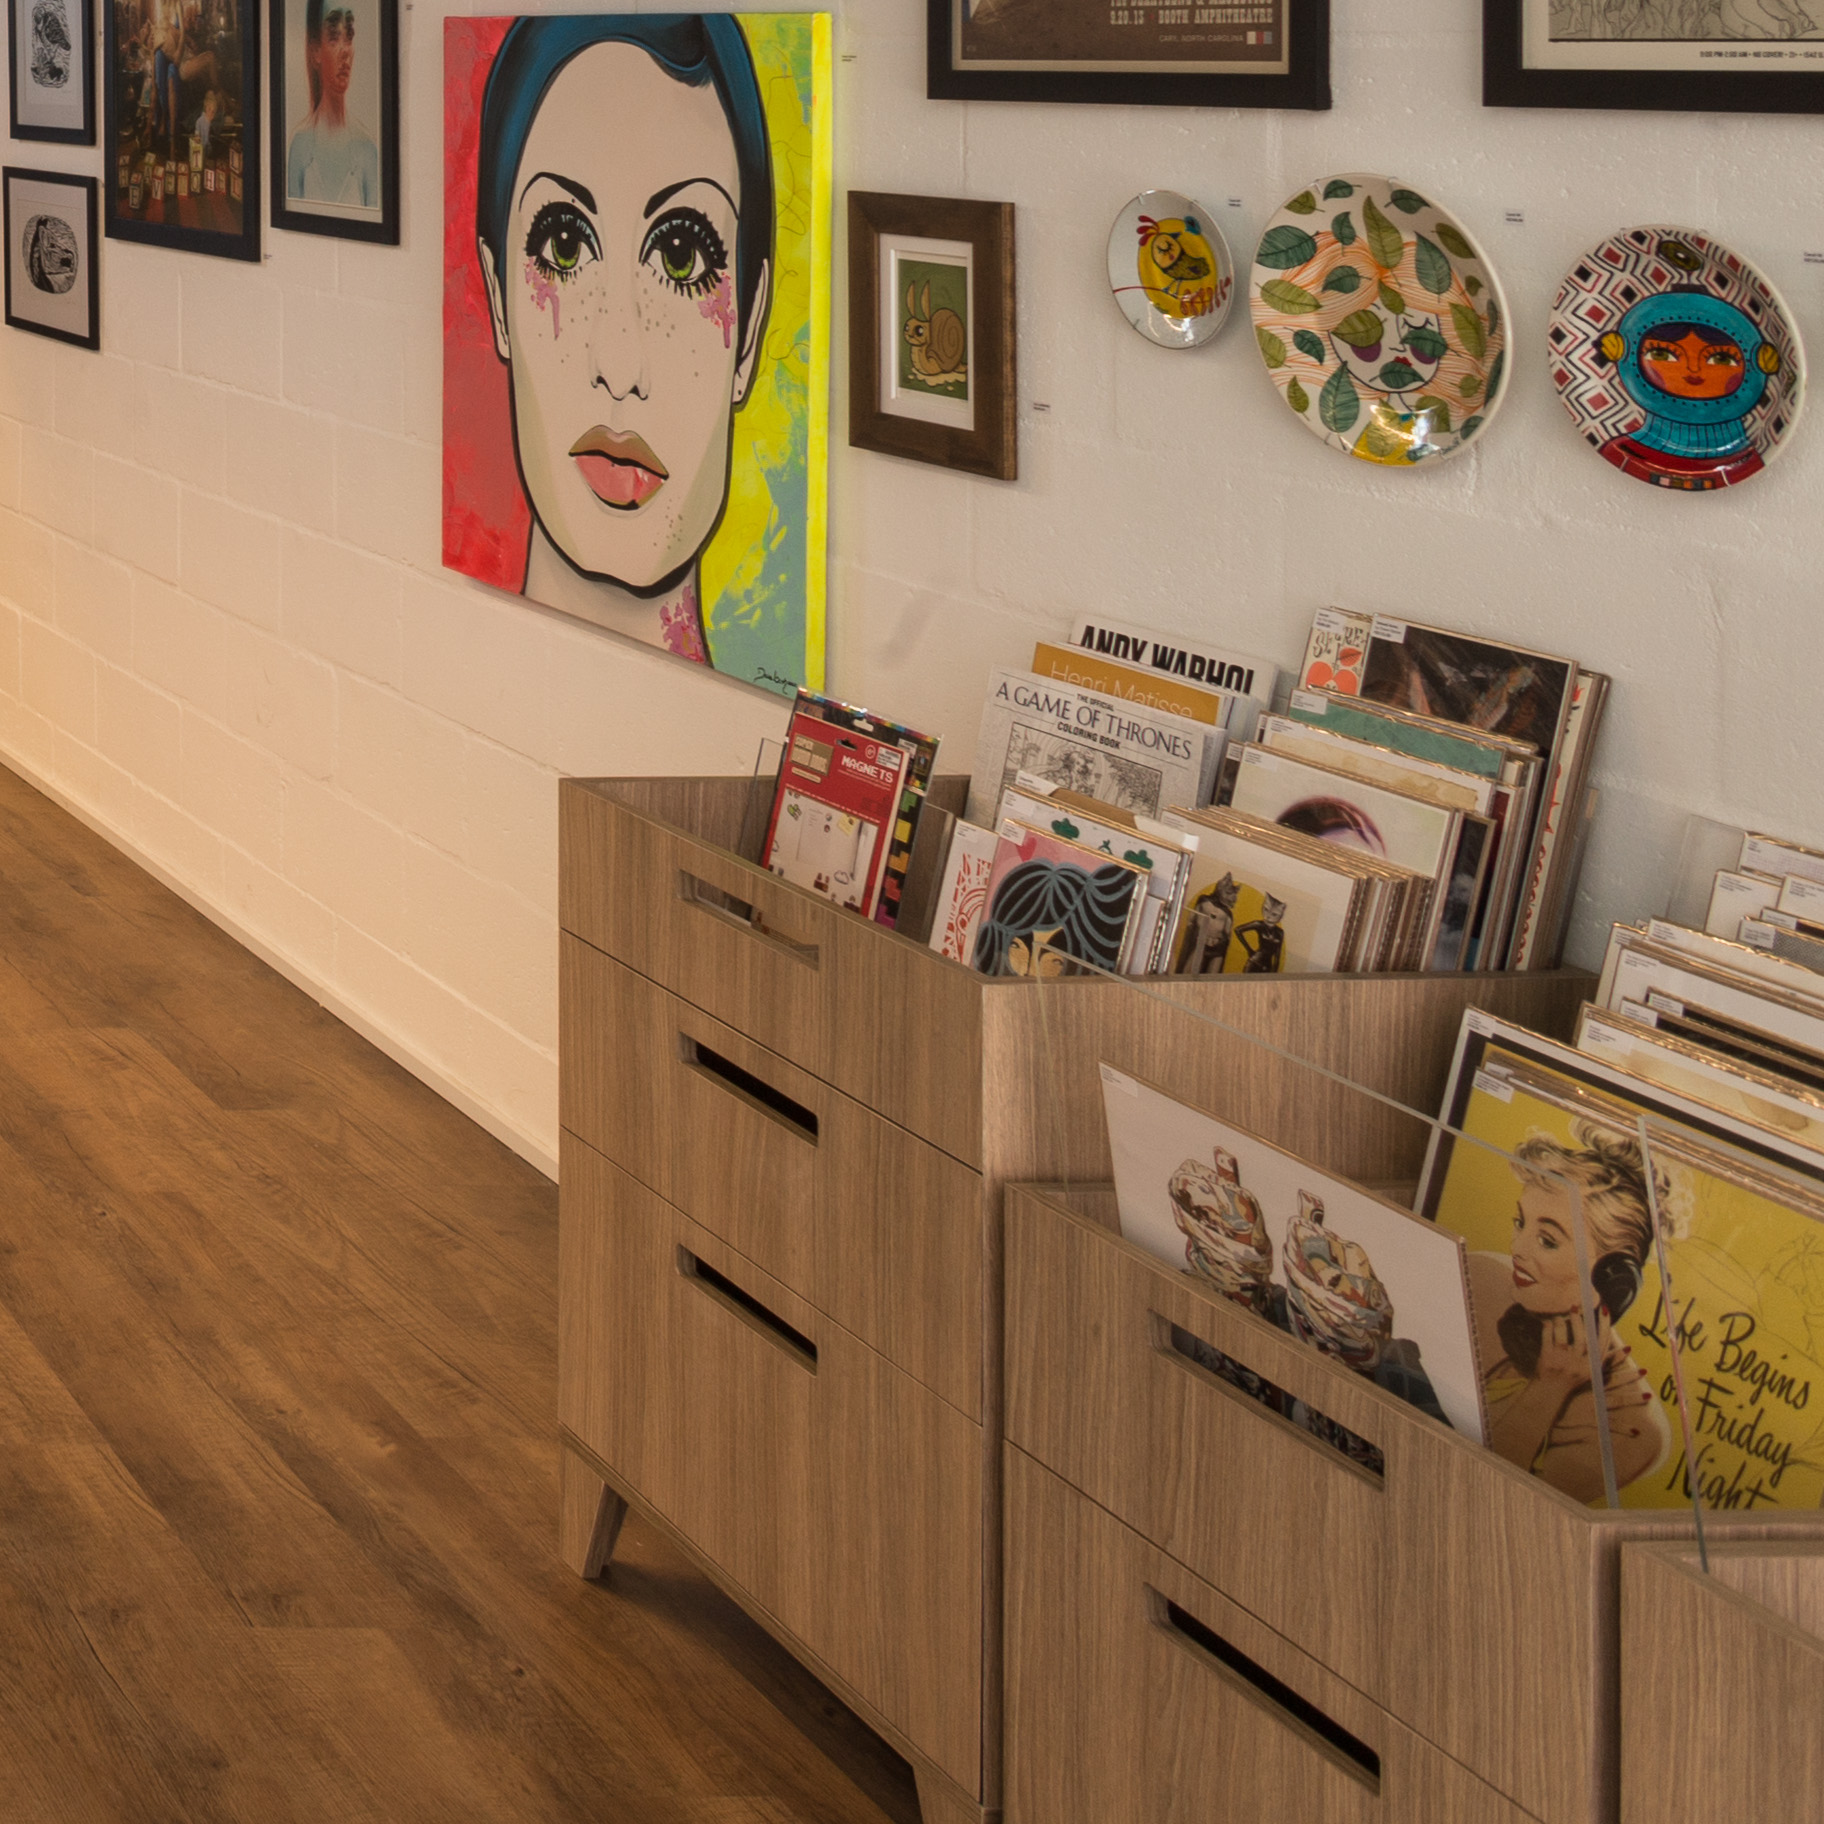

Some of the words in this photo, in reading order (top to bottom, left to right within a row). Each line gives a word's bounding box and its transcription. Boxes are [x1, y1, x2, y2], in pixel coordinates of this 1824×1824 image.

[1158, 9, 1189, 24] BOOTH
[1194, 8, 1273, 24] AMPHITHEATRE
[1052, 661, 1108, 693] Henri
[1113, 679, 1193, 718] Matisse
[996, 681, 1009, 700] A
[1014, 685, 1071, 721] GAME
[1076, 706, 1100, 728] OF
[1106, 713, 1192, 760] THRONES
[1057, 721, 1099, 743] COLORING
[1100, 734, 1122, 750] BOOK
[842, 755, 893, 783] MAGNETS
[1715, 1312, 1810, 1410] Begins
[1696, 1378, 1792, 1489] Friday
